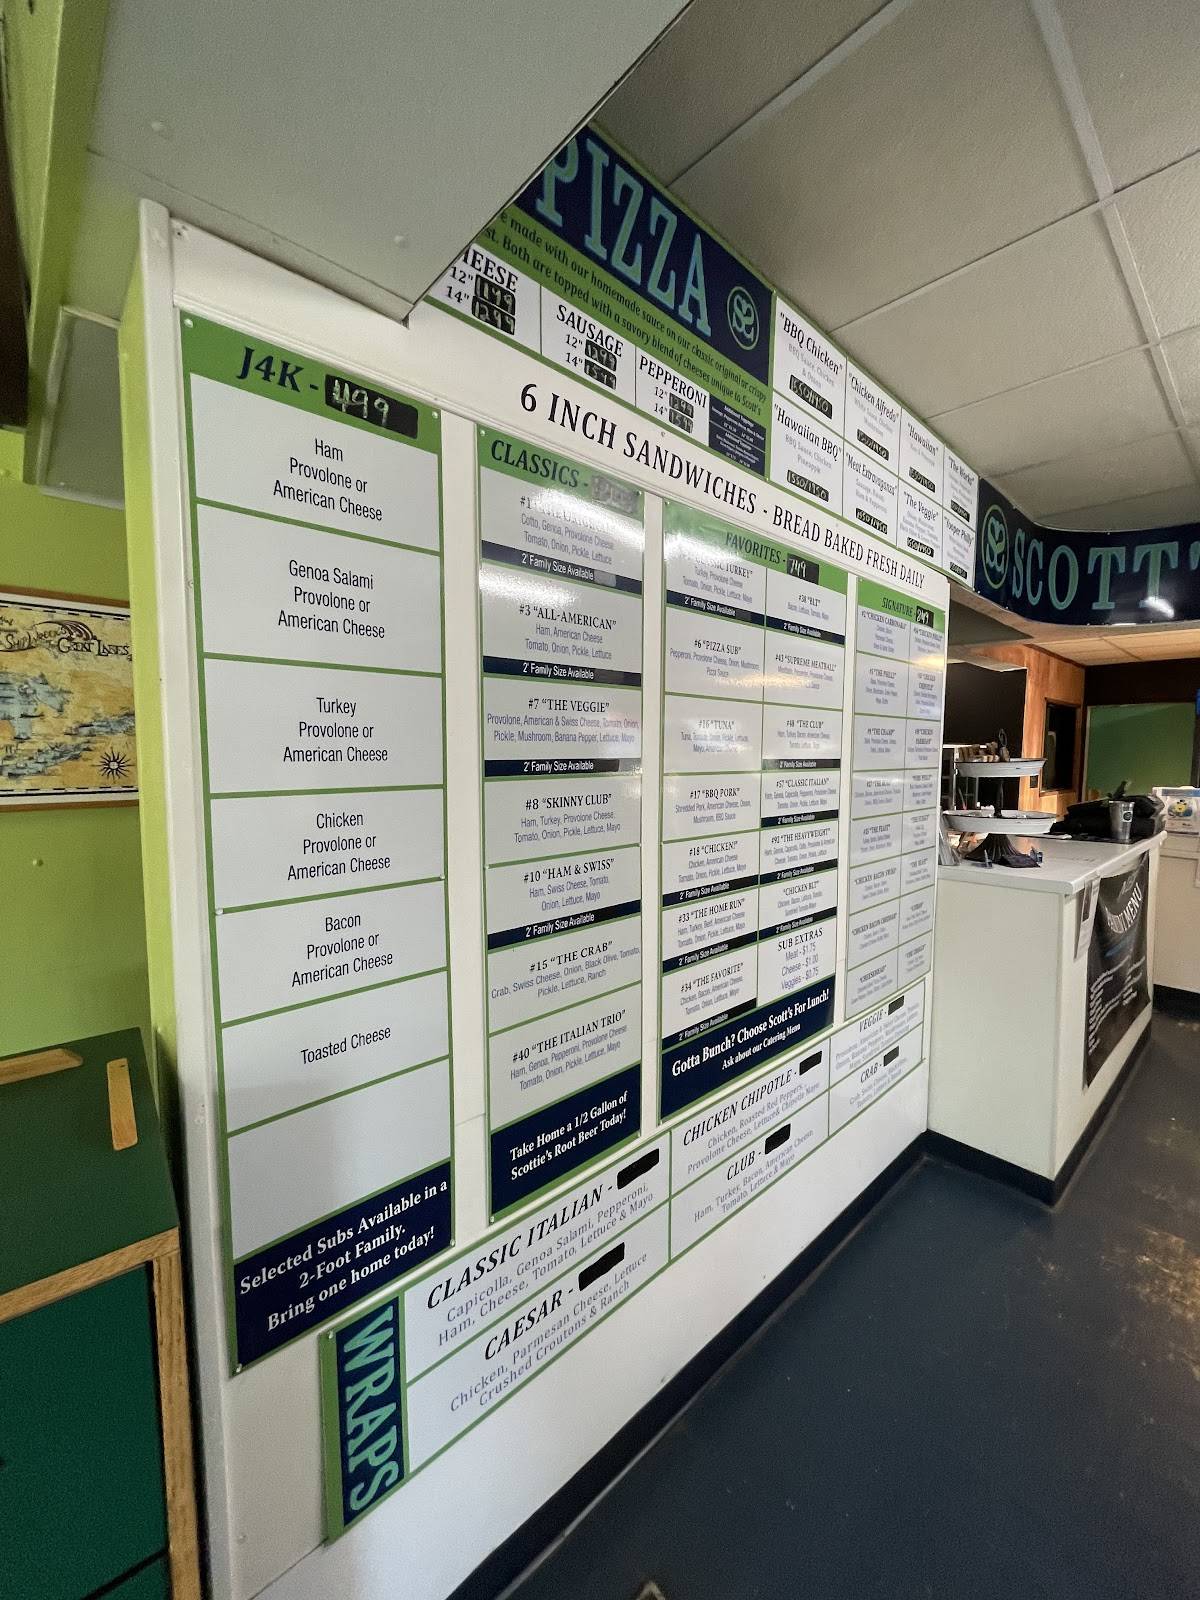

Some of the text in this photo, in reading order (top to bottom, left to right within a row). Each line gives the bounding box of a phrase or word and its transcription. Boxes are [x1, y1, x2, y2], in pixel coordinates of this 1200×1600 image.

[535, 136, 713, 337] PIZZA
[450, 266, 473, 284] 12"
[510, 218, 542, 246] made
[546, 242, 568, 266] with
[571, 260, 590, 279] our
[591, 270, 640, 316] homemade
[642, 311, 664, 333] sauce
[446, 286, 470, 304] 14"
[502, 235, 530, 264] Both
[532, 260, 552, 278] are
[554, 270, 589, 305] topped
[592, 297, 612, 319] with
[622, 317, 650, 344] savory
[652, 337, 674, 359] blend
[684, 356, 710, 382] cheeses
[556, 304, 624, 357] SAUSAGE
[236, 347, 304, 392] J4K
[640, 355, 707, 408] PEPPERONI
[315, 438, 343, 462] Ham
[491, 440, 580, 488] CLASSICS
[290, 457, 368, 493] Provolone or
[521, 383, 537, 412] 6
[548, 392, 618, 450] INCH
[623, 431, 757, 514] SANDWICHES
[773, 505, 820, 542] BREAD
[824, 529, 864, 563] BAKED
[866, 548, 898, 576] FRESH
[900, 564, 925, 588] DAILY
[273, 480, 382, 522] American Cheese
[726, 532, 781, 564] FAVORITES
[289, 560, 374, 590] Genoa Salami
[294, 586, 370, 612] Provolone or
[519, 604, 530, 616] #3
[278, 610, 385, 639] American Cheese
[316, 697, 356, 718] Turkey
[528, 698, 540, 710] #7
[299, 722, 374, 740] Provolone or
[283, 746, 388, 762] American Cheese
[526, 798, 538, 810] #8
[316, 812, 364, 829] Chicken
[303, 835, 376, 854] Provolone or
[288, 855, 390, 881] American Cheese
[524, 871, 540, 884] #10
[574, 864, 582, 875] &
[325, 914, 361, 932] Bacon
[307, 932, 380, 960] Provolone or
[778, 928, 823, 952] SUB EXTRAS
[292, 952, 393, 988] American Cheese
[530, 960, 548, 972] #15
[782, 962, 800, 976] Cheese
[672, 988, 829, 1077] Gotta Bunch? Choose Scott's For Lunch!
[859, 1009, 883, 1032] VEGGIE
[300, 1025, 391, 1066] Toasted Cheese
[512, 1047, 530, 1064] #40
[560, 1020, 600, 1046] ITALIAN
[722, 1024, 800, 1070] Ask about our Catering Menu
[860, 1062, 879, 1083] CRAB
[683, 1068, 792, 1146] CHICKEN CHIPOTLE
[509, 1090, 628, 1162] Take Home a 1/2 Gallon of
[510, 1108, 627, 1180] Scottie's Root Beer Today!
[728, 1150, 756, 1180] CLUB
[239, 1180, 448, 1295] Selected Subs Available in a
[427, 1184, 604, 1310] CLASSIC ITALIAN
[299, 1223, 406, 1289] 2-Foot Family.
[267, 1226, 435, 1332] Bring one home today!
[484, 1289, 564, 1360] CAESAR
[344, 1305, 400, 1512] WRAPS
